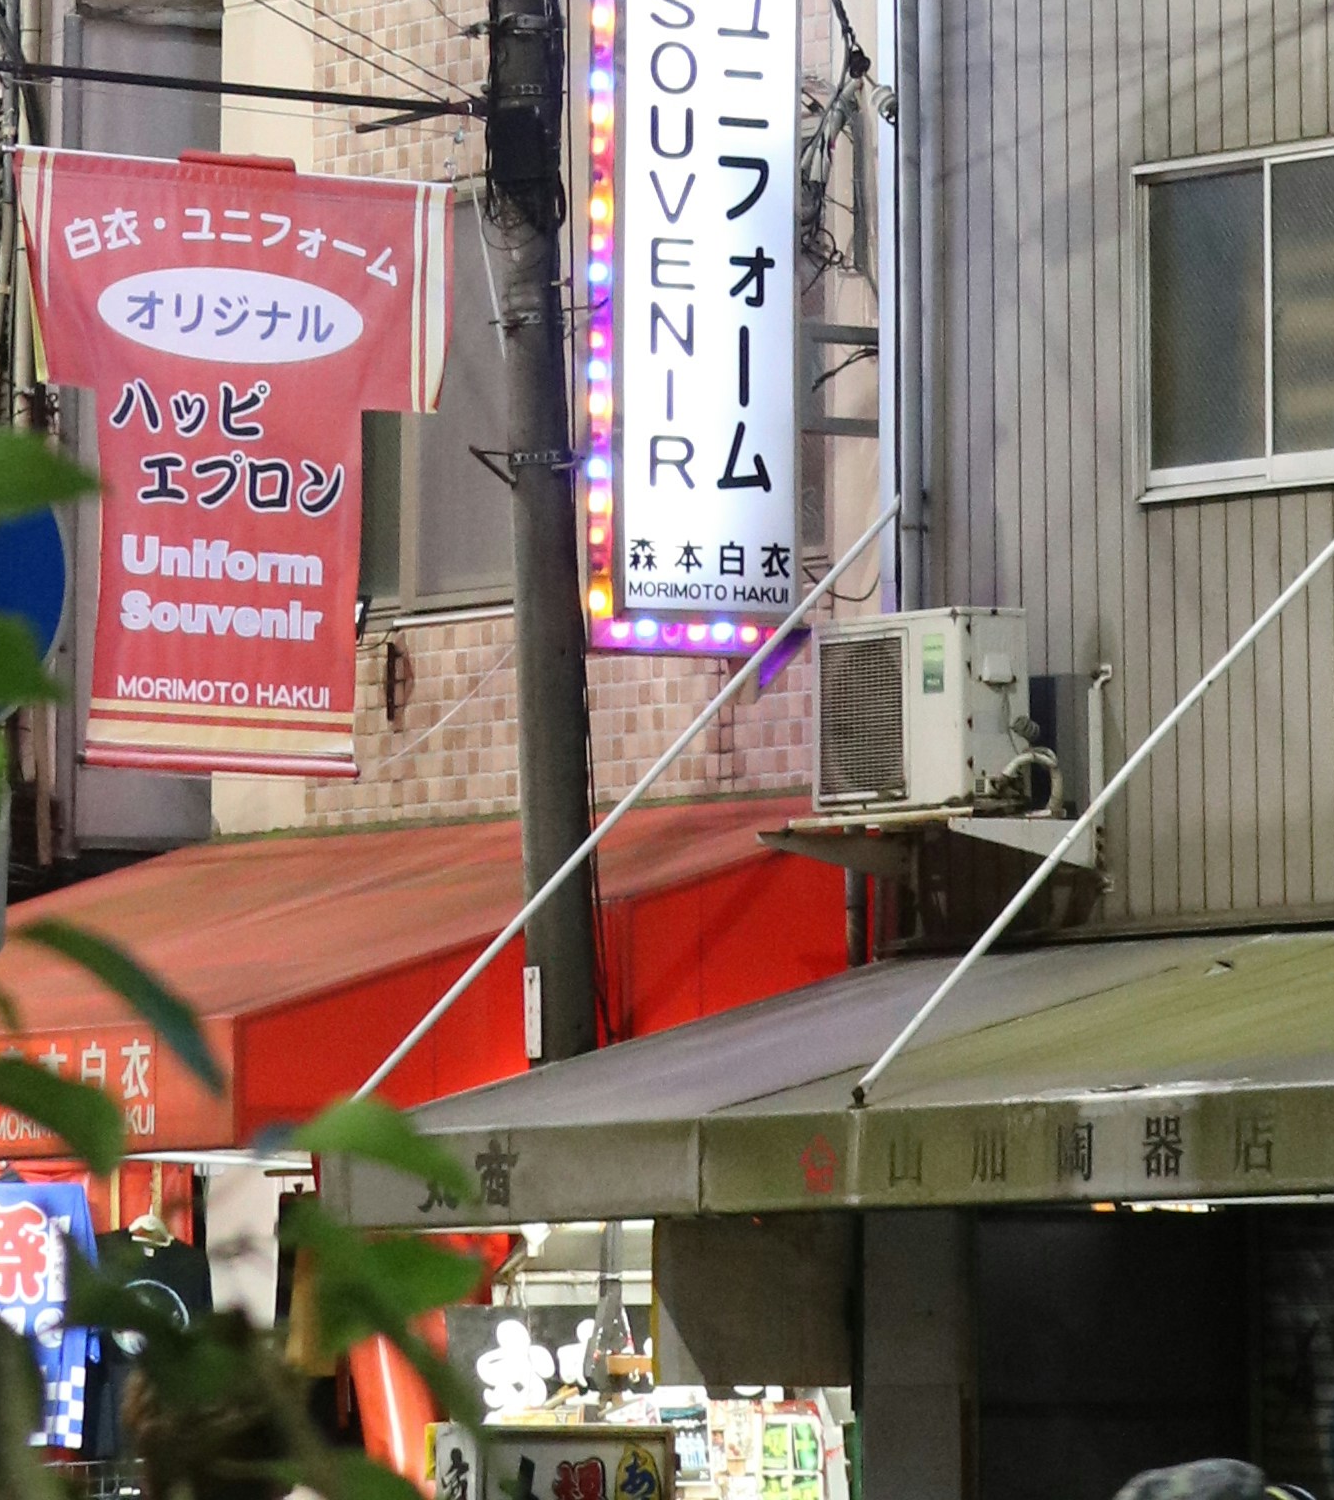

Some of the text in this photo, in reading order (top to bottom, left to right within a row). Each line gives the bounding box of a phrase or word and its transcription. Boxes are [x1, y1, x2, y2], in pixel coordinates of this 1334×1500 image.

[64, 206, 399, 286] 白衣・ユニフォーム
[126, 290, 335, 344] オリジナル
[110, 380, 271, 440] ハッピ
[139, 453, 346, 517] エプロン
[121, 534, 324, 587] Uniform
[629, 538, 791, 579] 森本白衣
[121, 591, 324, 641] Souvenir
[629, 581, 789, 604] MORIMOTO HAKUI
[117, 675, 331, 710] MORIMOTO HAKUI
[889, 1116, 1273, 1187] 山加陶器店
